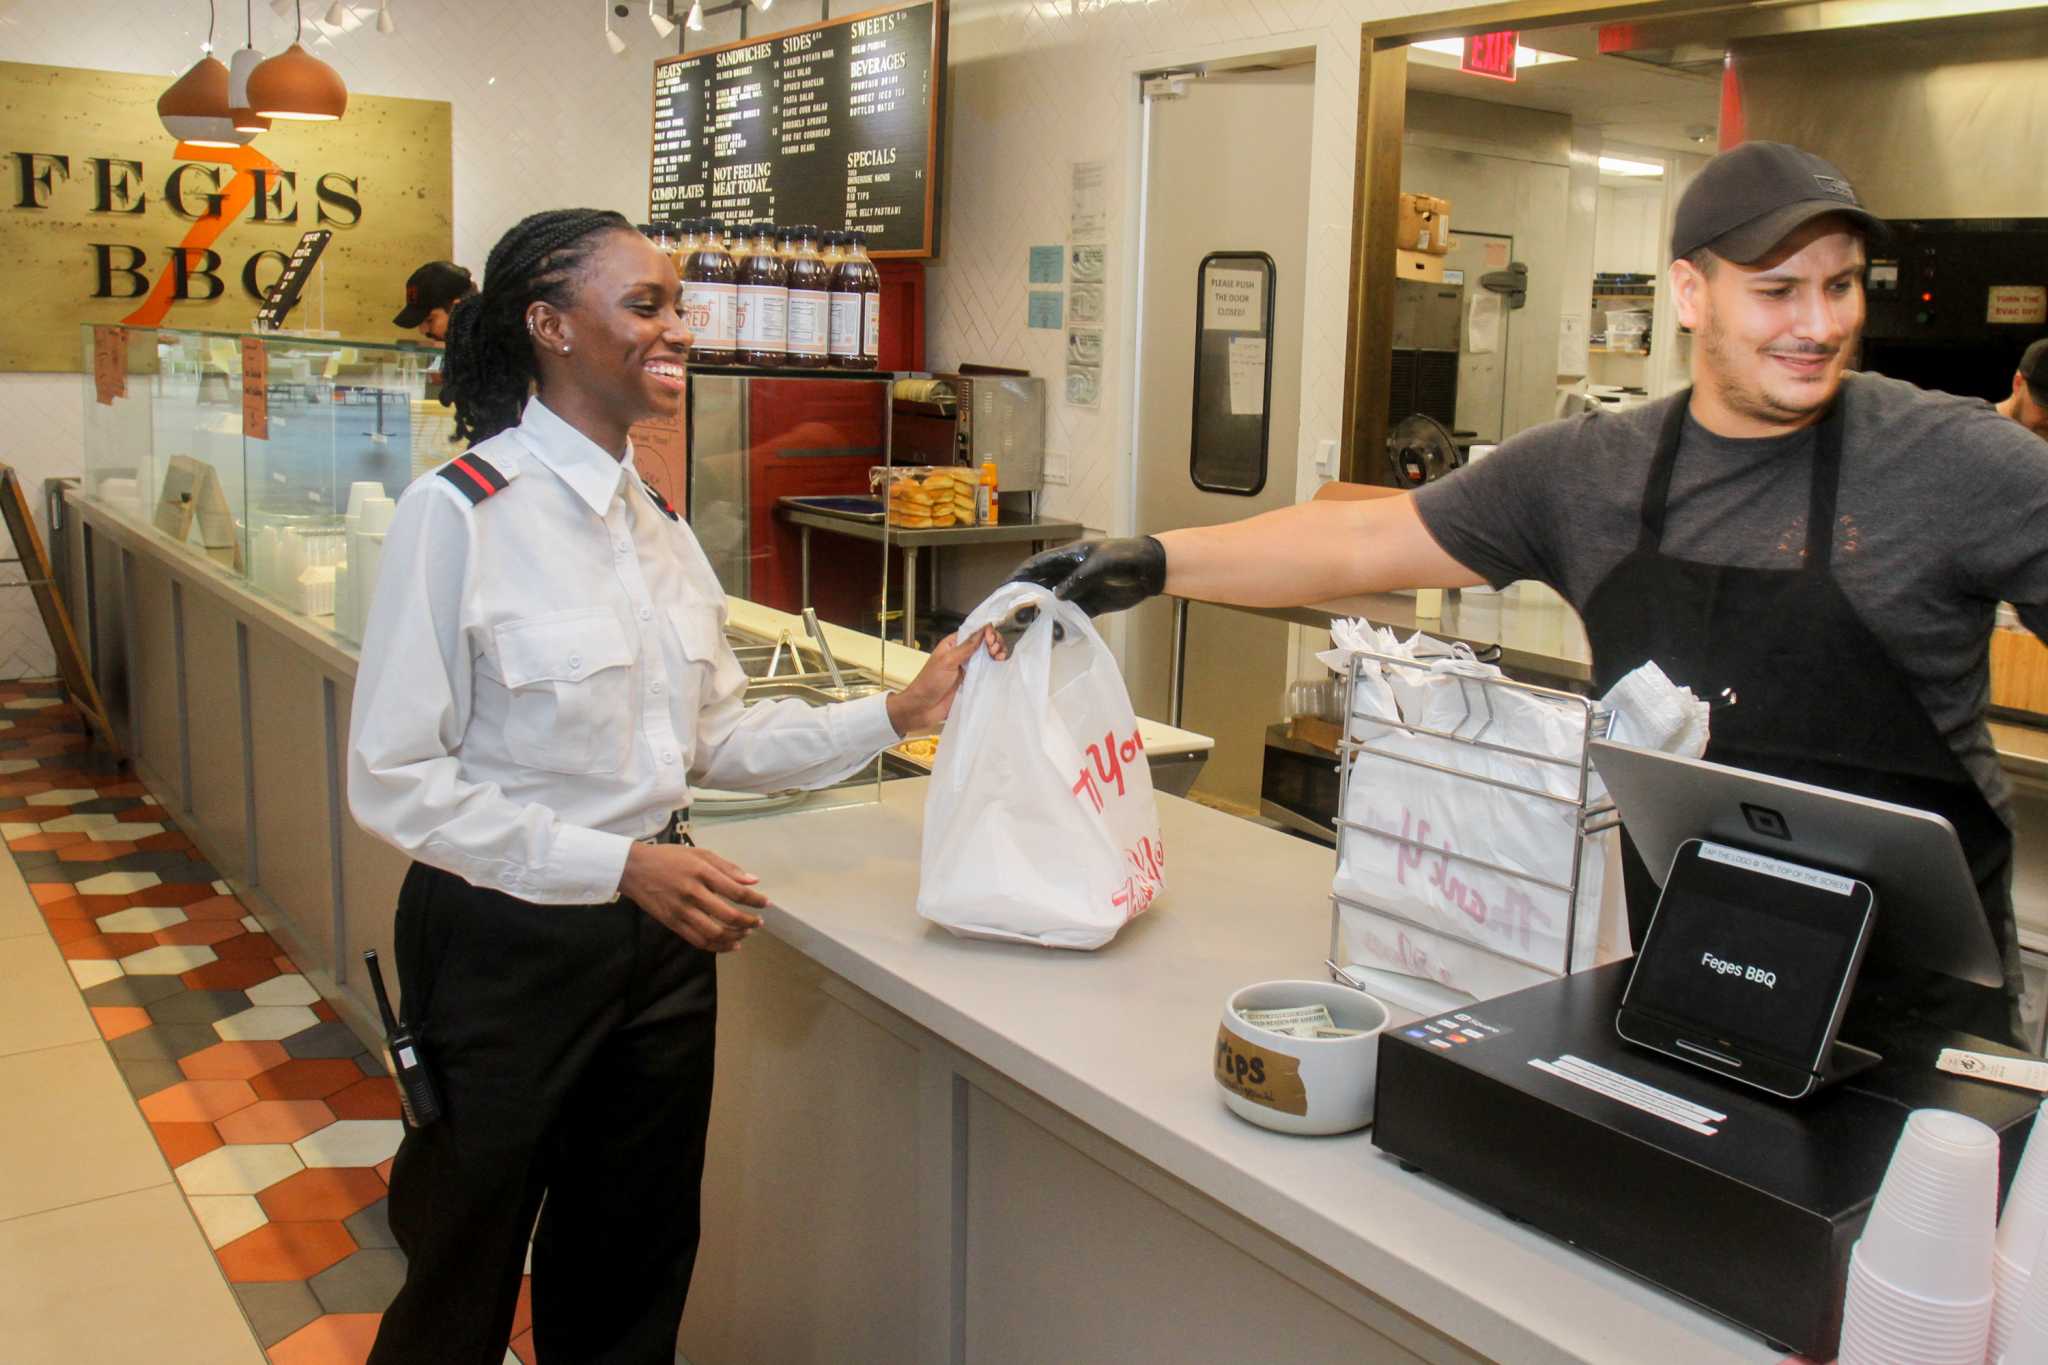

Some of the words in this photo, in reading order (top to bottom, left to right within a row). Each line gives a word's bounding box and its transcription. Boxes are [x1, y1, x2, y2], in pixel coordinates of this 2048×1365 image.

[851, 14, 895, 39] SWEETS
[783, 34, 812, 54] SIDES
[1472, 32, 1514, 73] EXIT
[715, 43, 772, 68] SANDWICHES
[850, 52, 906, 78] BEVERAGES
[656, 65, 681, 79] MEATS
[847, 147, 896, 169] SPECIALS
[713, 165, 732, 182] NOT
[733, 162, 771, 179] FEELING
[10, 150, 363, 229] FEGES
[652, 186, 677, 201] COMBO
[678, 184, 705, 200] PLATES
[712, 181, 736, 197] MEAT
[88, 242, 303, 309] BBQ
[1228, 294, 1250, 303] DOOR
[1996, 295, 2020, 304] TURN
[2022, 295, 2040, 304] THE
[1702, 951, 1742, 977] Feges
[1744, 965, 1778, 990] BBQ
